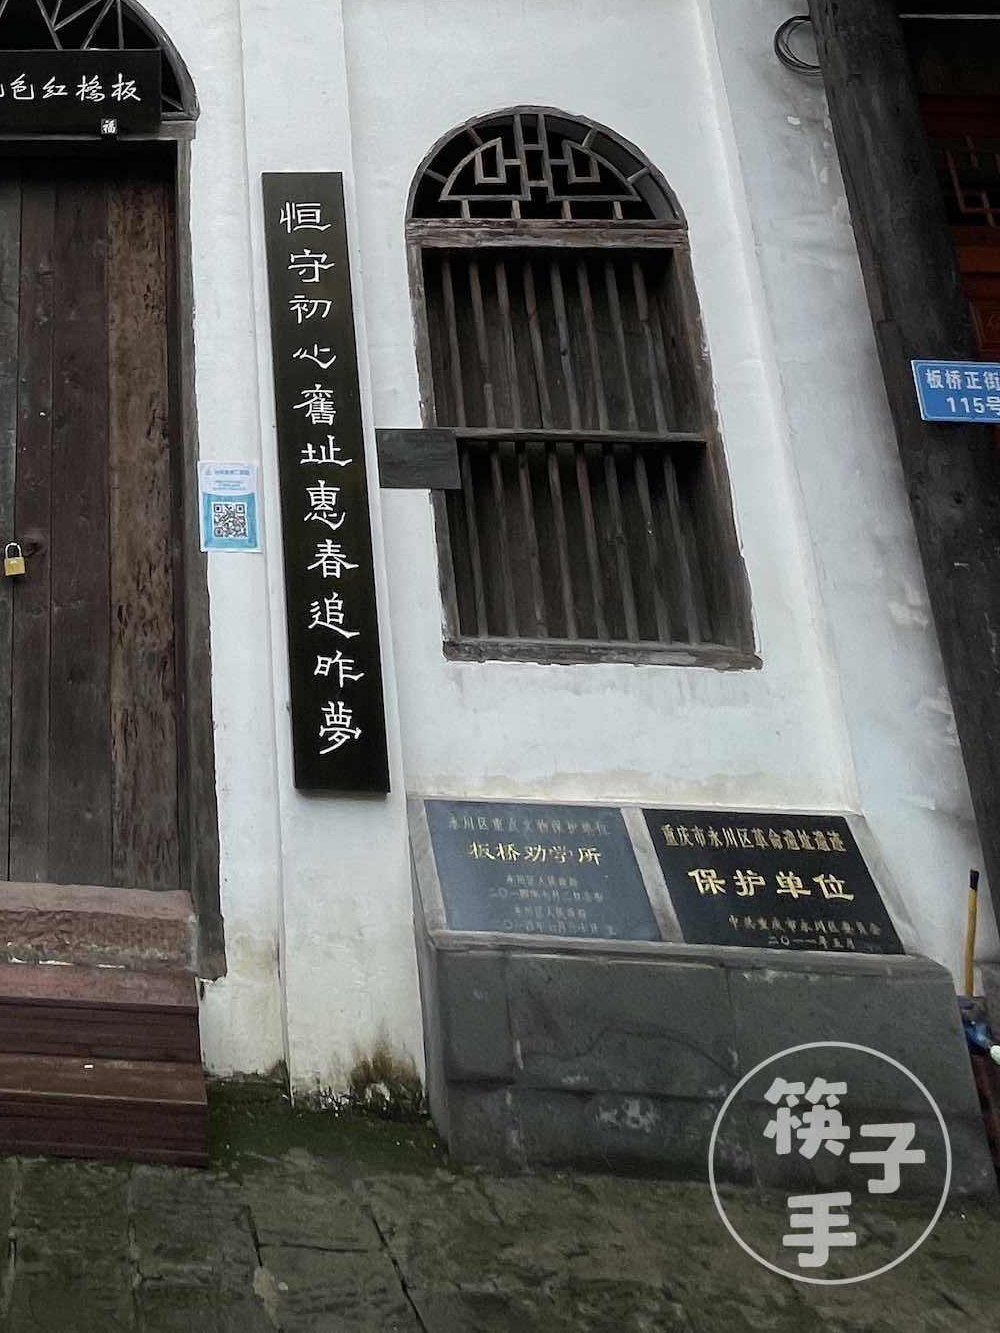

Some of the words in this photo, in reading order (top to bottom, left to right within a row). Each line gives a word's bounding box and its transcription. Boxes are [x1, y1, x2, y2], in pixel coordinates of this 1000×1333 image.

[924, 368, 1000, 392] 板桥正街
[945, 395, 1000, 416] 115号
[468, 841, 602, 866] 板桥劝学所
[687, 868, 855, 901] 保护单位
